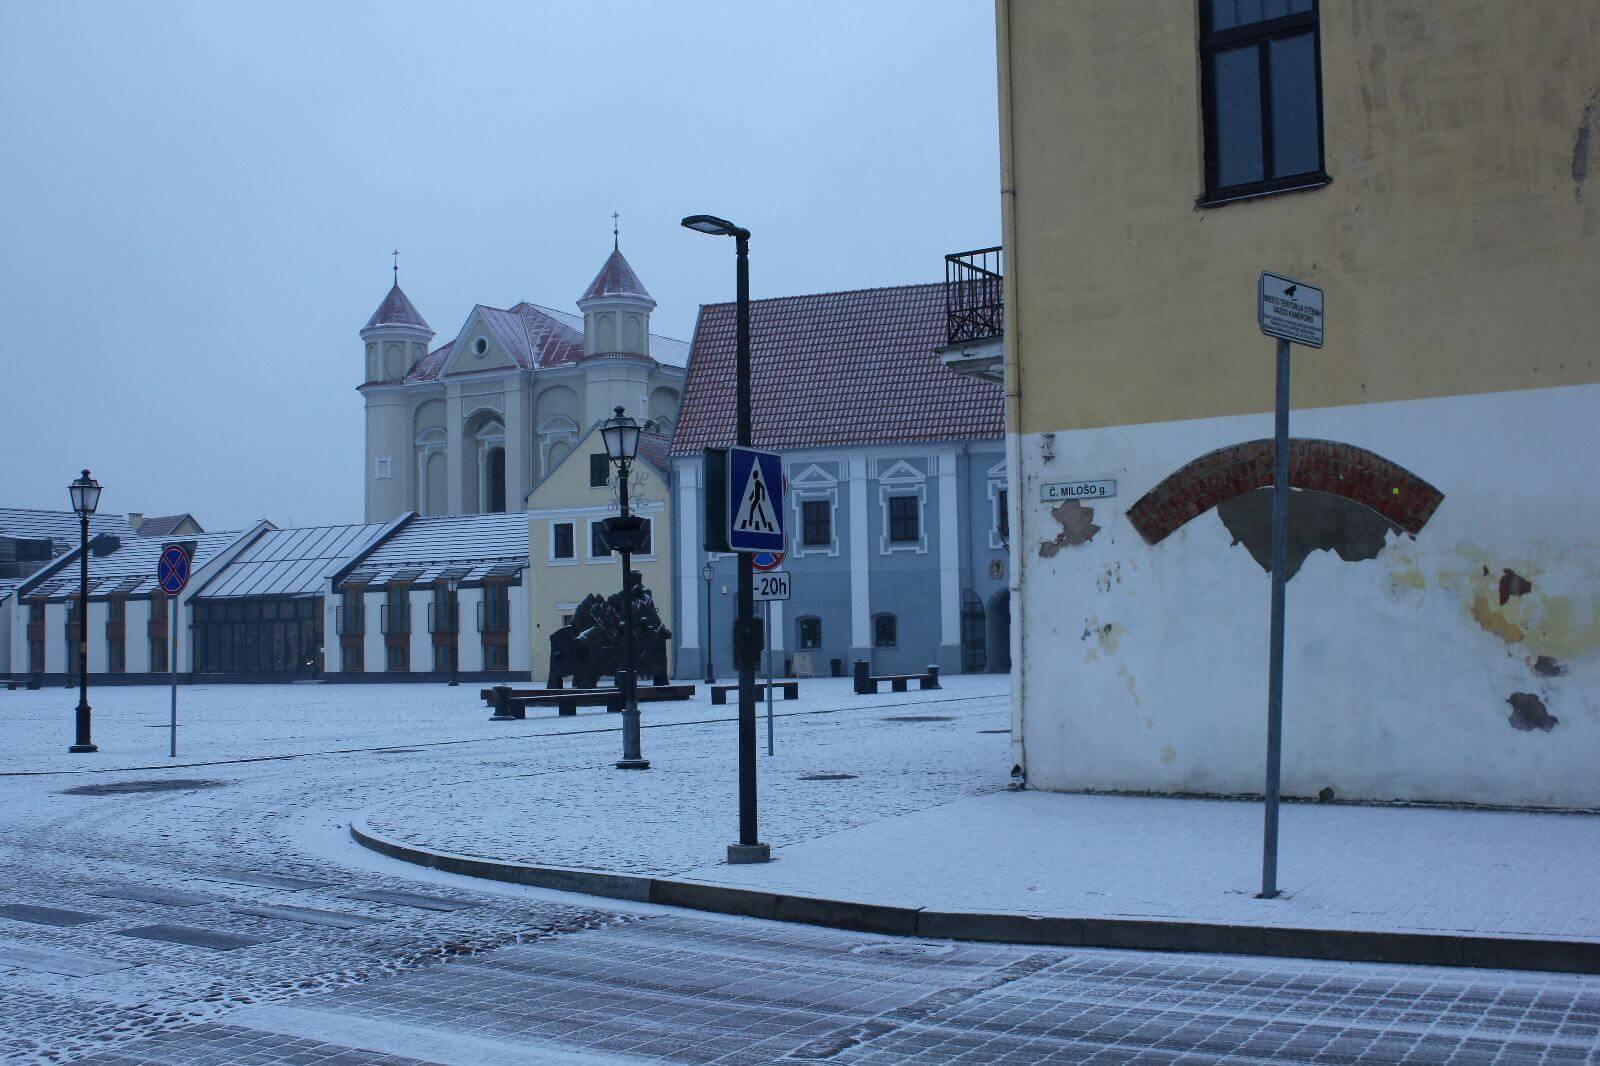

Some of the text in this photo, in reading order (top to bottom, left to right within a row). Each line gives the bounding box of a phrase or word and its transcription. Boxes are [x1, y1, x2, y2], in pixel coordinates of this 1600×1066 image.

[1049, 484, 1108, 497] Č. MILOŠO g.
